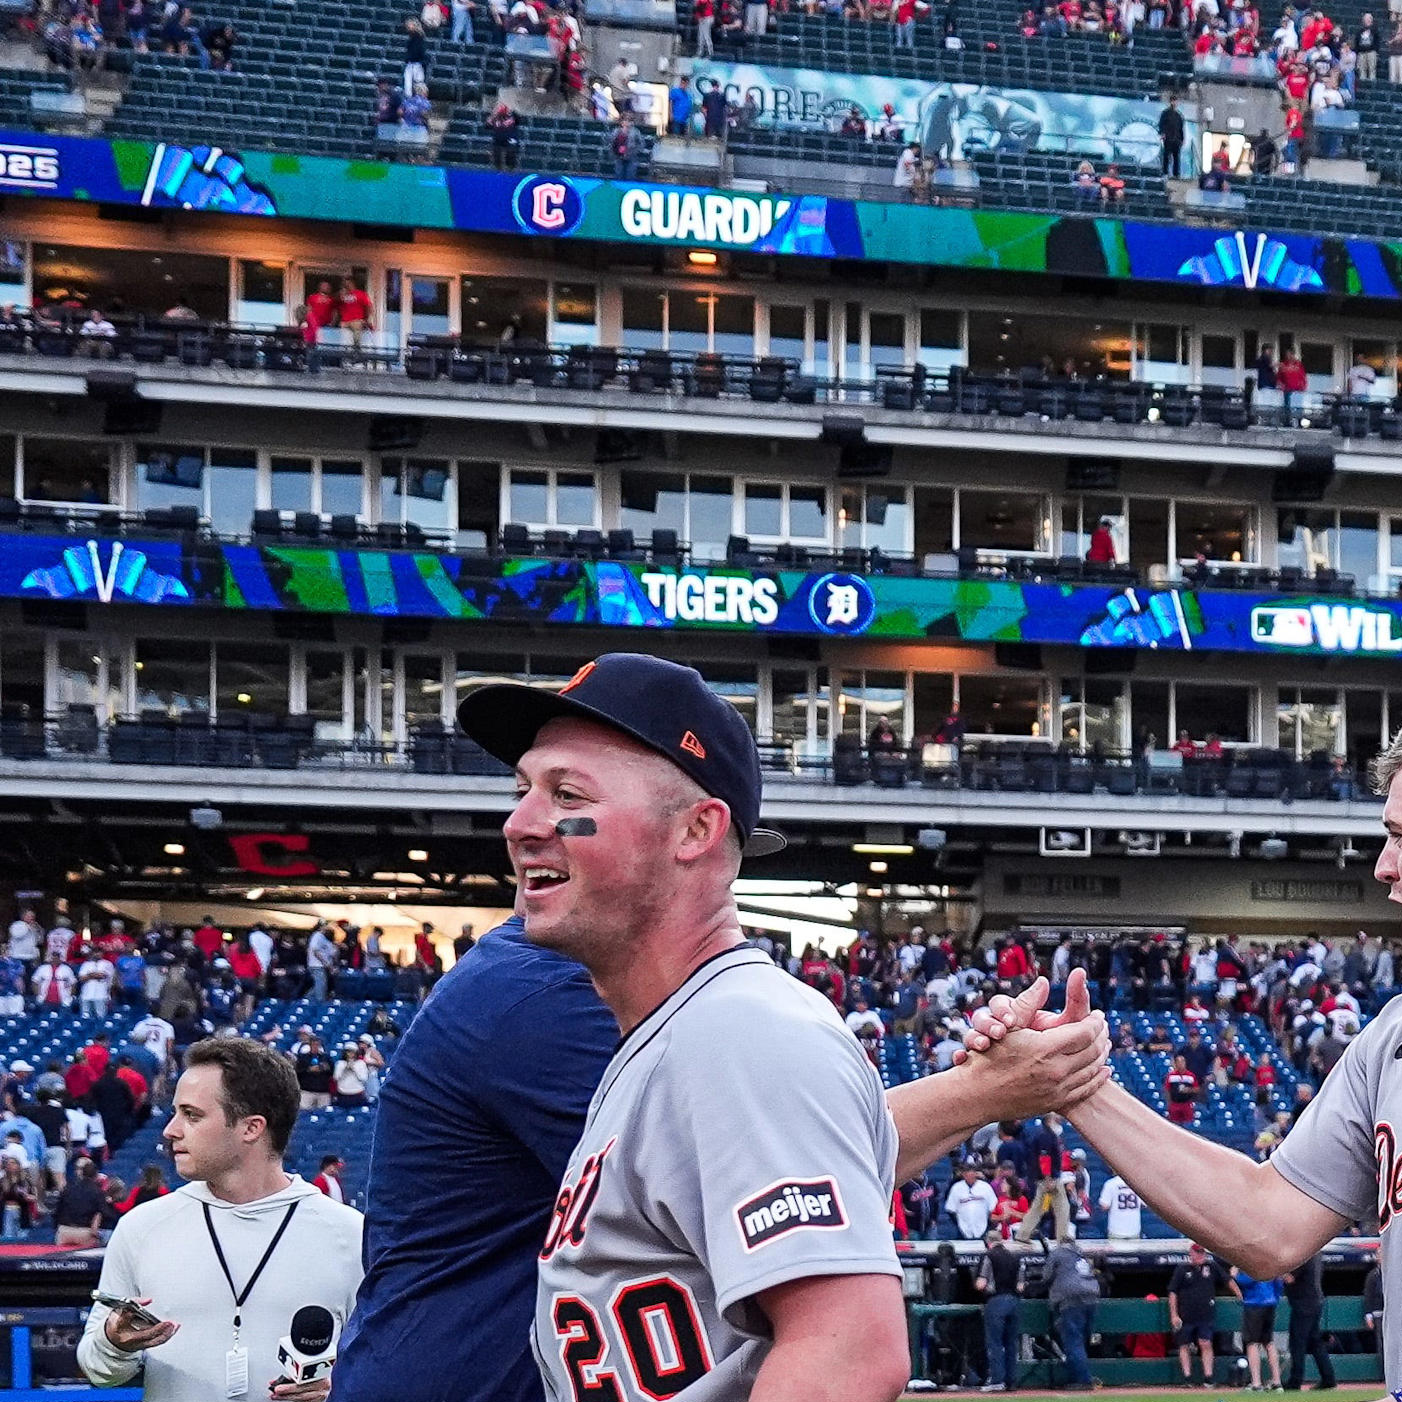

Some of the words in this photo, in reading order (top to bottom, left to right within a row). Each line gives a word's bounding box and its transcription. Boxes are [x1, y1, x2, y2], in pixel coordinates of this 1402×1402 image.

[620, 188, 791, 244] GUARDI
[641, 572, 779, 625] TIGERS
[744, 1186, 833, 1237] meijer
